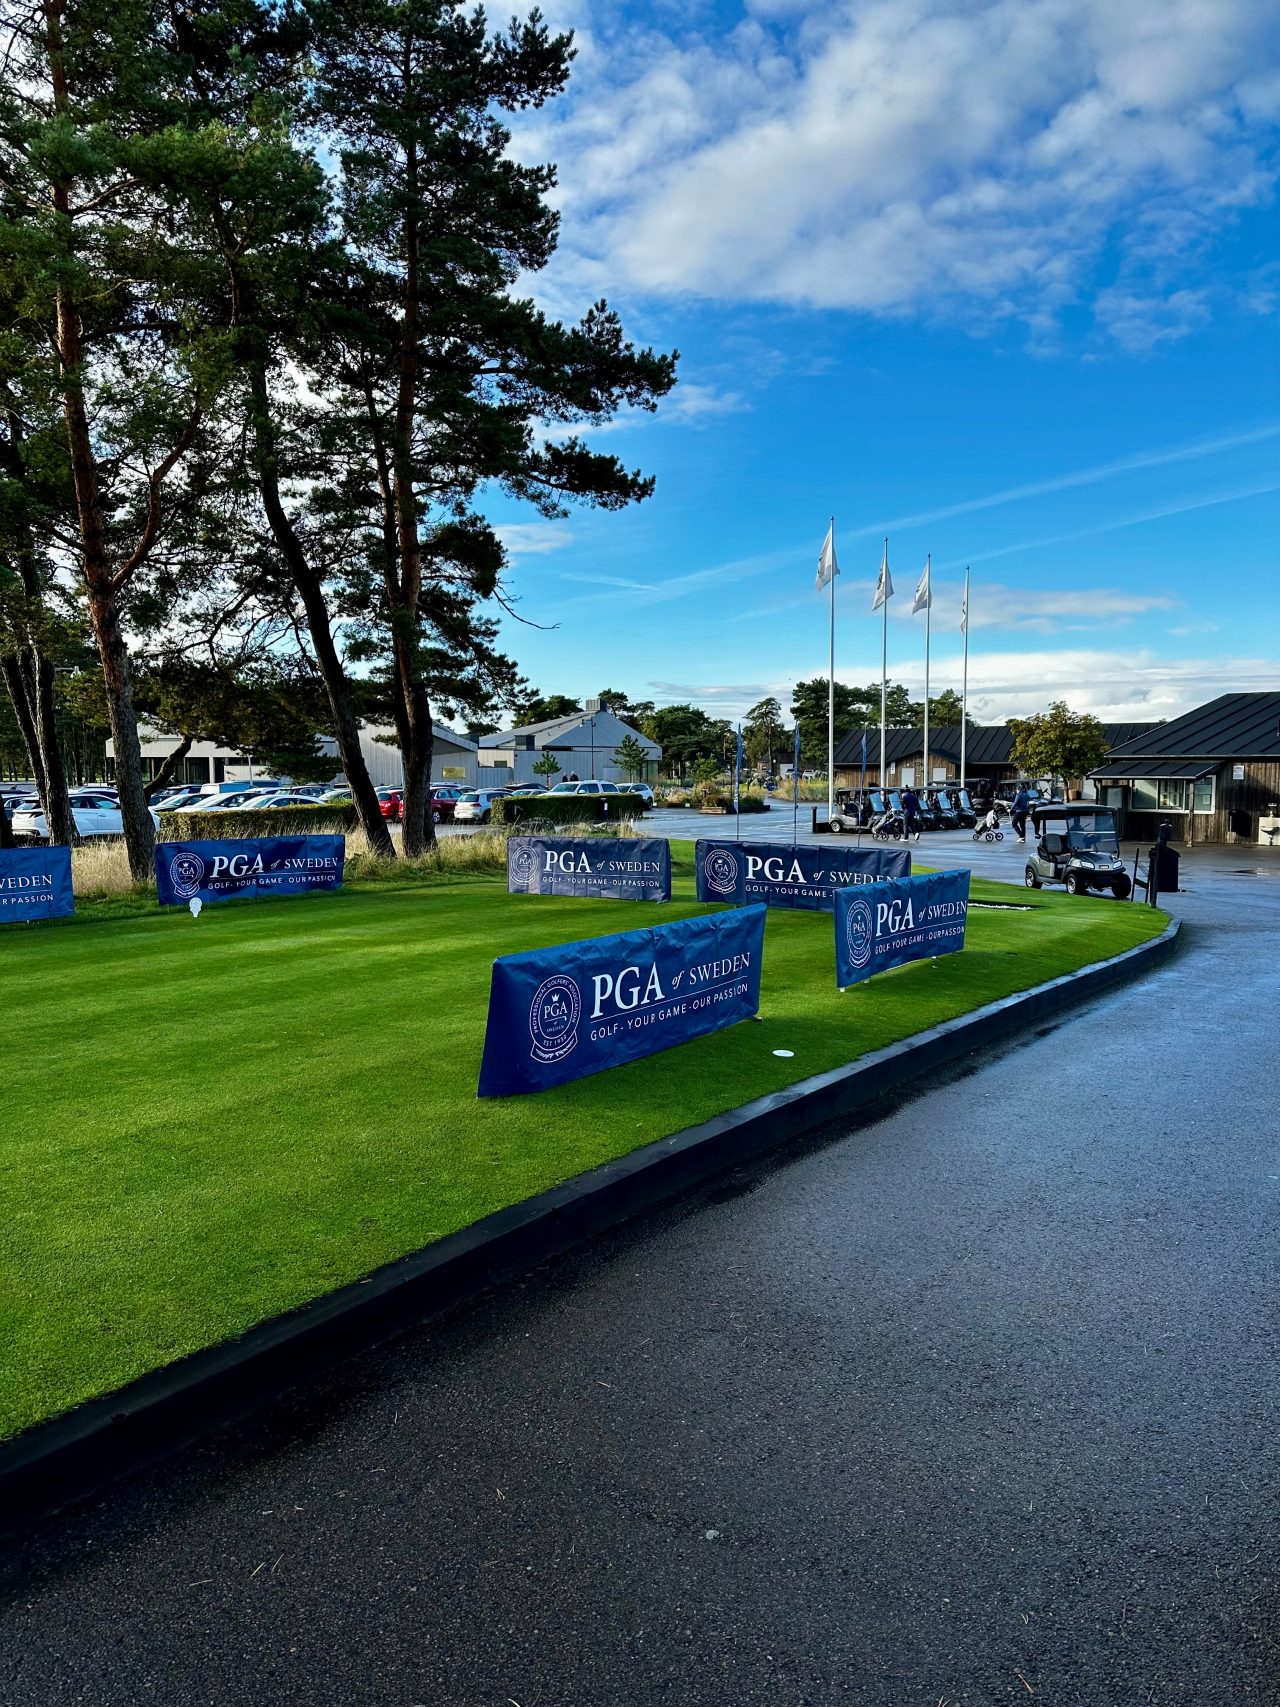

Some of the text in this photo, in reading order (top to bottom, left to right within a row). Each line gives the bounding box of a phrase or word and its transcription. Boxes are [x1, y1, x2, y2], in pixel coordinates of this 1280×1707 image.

[209, 853, 265, 878] PGA
[270, 860, 281, 869] of
[543, 850, 593, 873] PGA
[596, 861, 605, 870] of
[609, 860, 660, 873] SWEDEN
[745, 855, 808, 884] PGA
[813, 870, 825, 881] of
[236, 879, 257, 887] YOUR
[11, 894, 54, 905] PASSION
[775, 887, 799, 895] YOUR
[801, 889, 827, 898] GAME
[875, 897, 915, 937] PGA
[918, 907, 927, 921] of
[852, 921, 866, 934] PGA
[892, 937, 907, 949] YOUR
[908, 933, 925, 945] GAME
[590, 951, 751, 1019] PGA of SWEDEN
[544, 1001, 568, 1019] PGA
[627, 1013, 656, 1030] YOUR
[658, 1003, 687, 1021] GAME
[713, 983, 748, 1003] PASSION
[543, 1039, 553, 1047] EST
